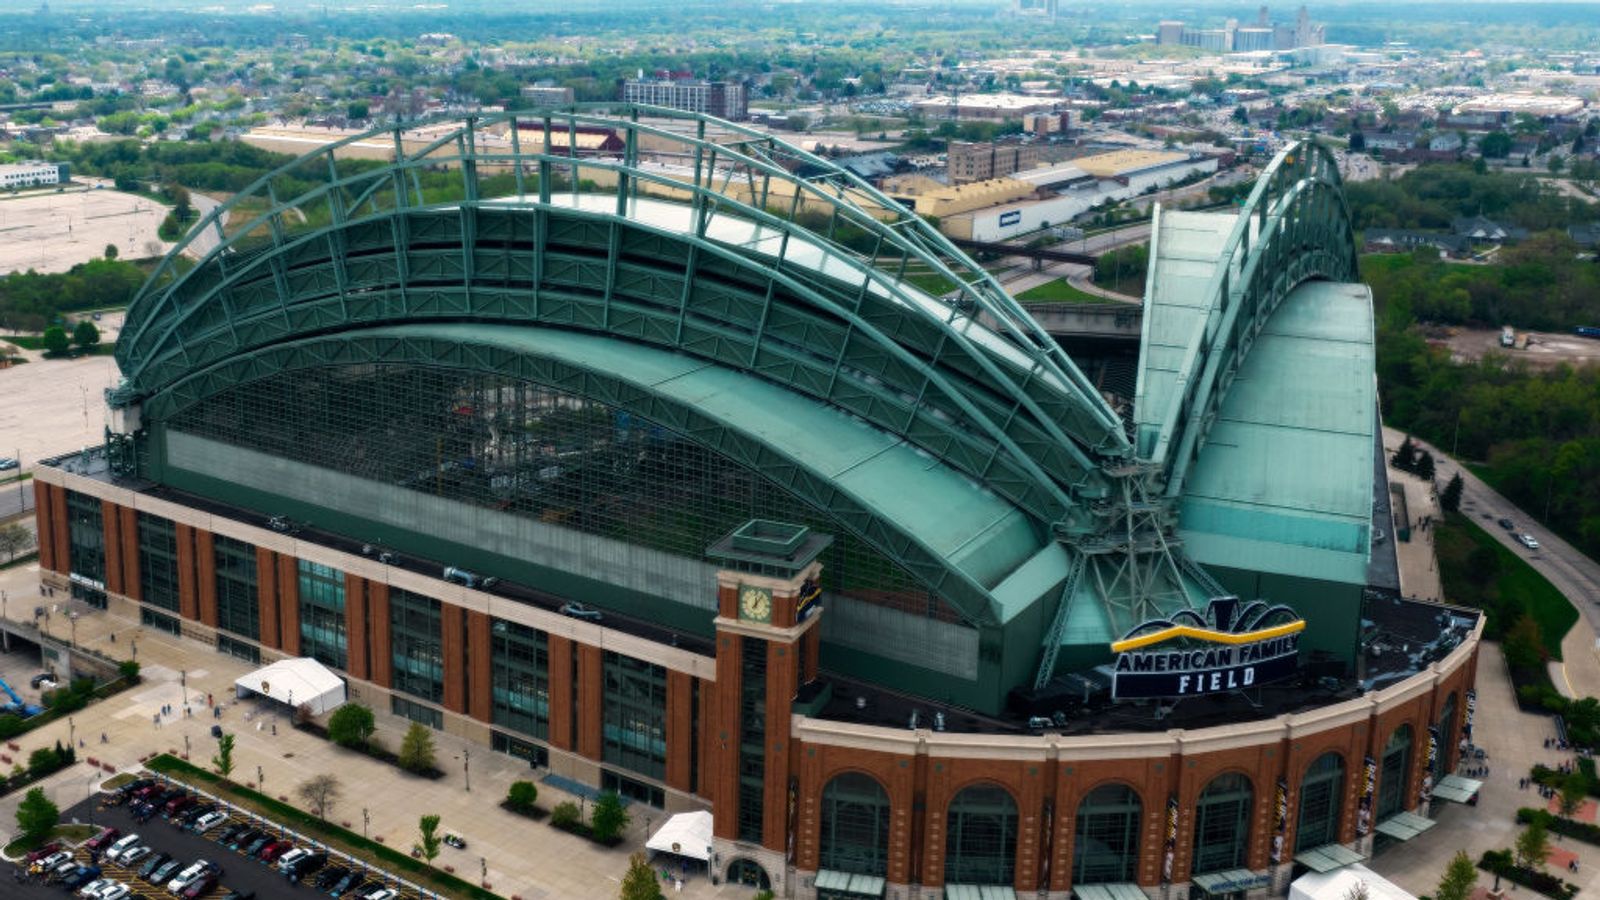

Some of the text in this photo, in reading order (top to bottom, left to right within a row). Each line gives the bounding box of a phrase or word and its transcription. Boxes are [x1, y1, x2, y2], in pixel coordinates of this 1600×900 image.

[1117, 633, 1299, 672] AMERICAN FAMILY
[1178, 667, 1255, 694] FIELD
